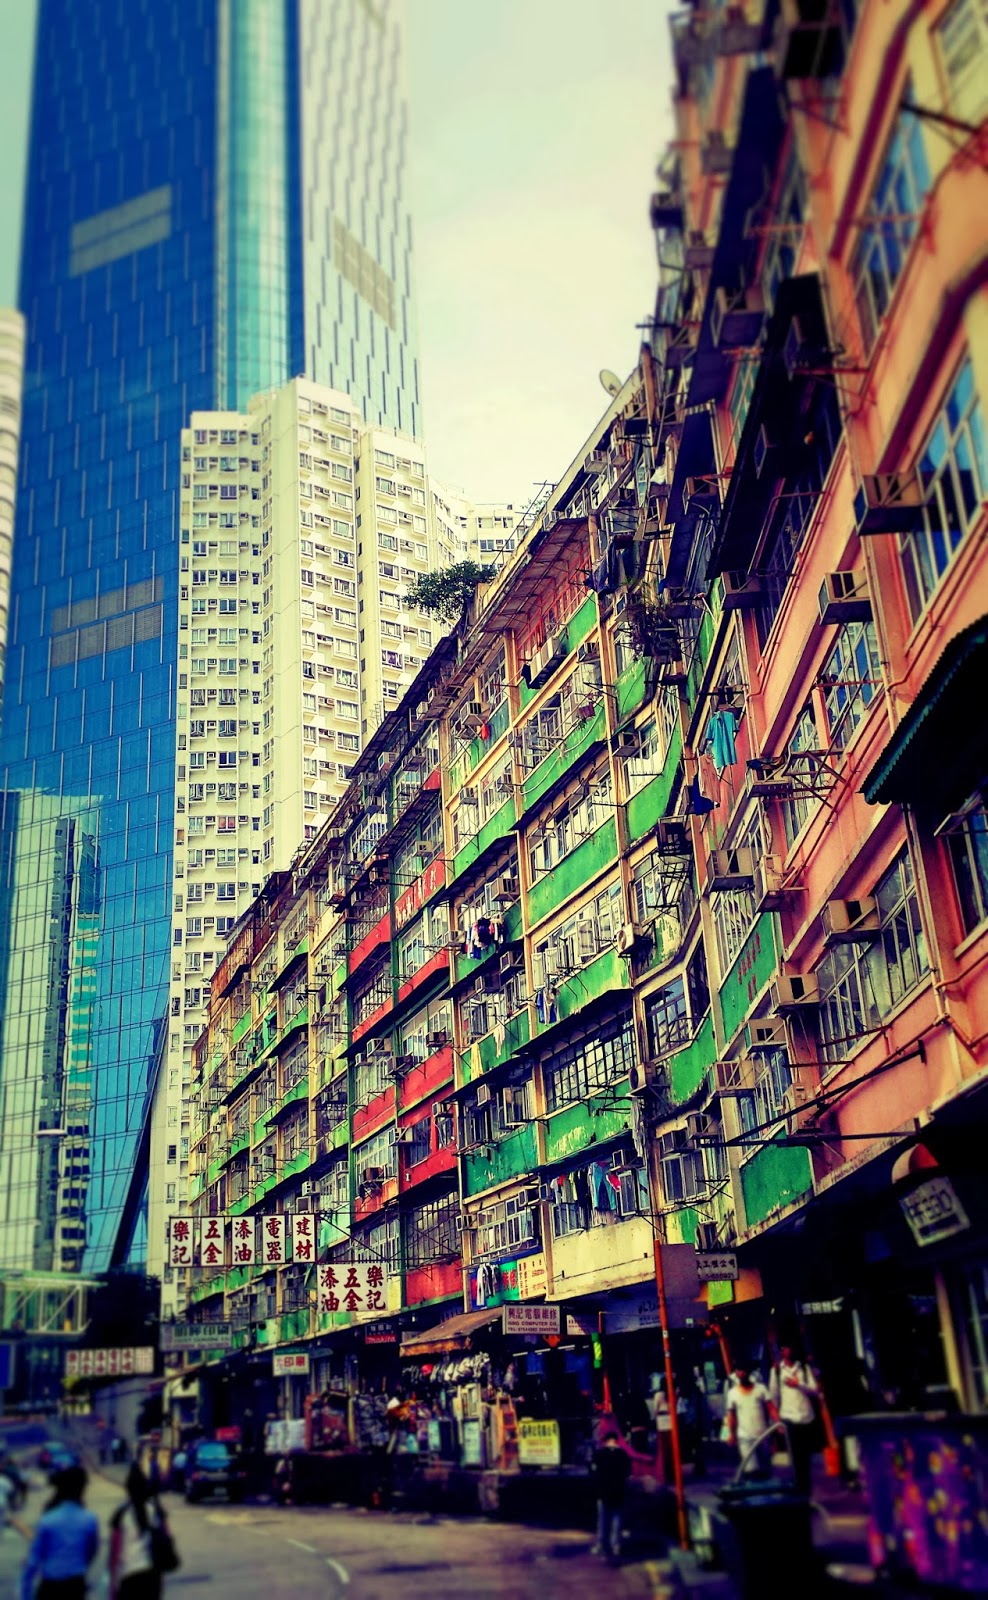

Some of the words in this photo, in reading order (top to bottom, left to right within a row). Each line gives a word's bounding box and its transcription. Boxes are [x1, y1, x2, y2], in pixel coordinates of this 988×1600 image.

[172, 1220, 191, 1264] 樂記
[203, 1220, 223, 1263] 五金
[234, 1221, 253, 1262] 漆油
[265, 1217, 282, 1261] 電器
[295, 1217, 312, 1260] 建材
